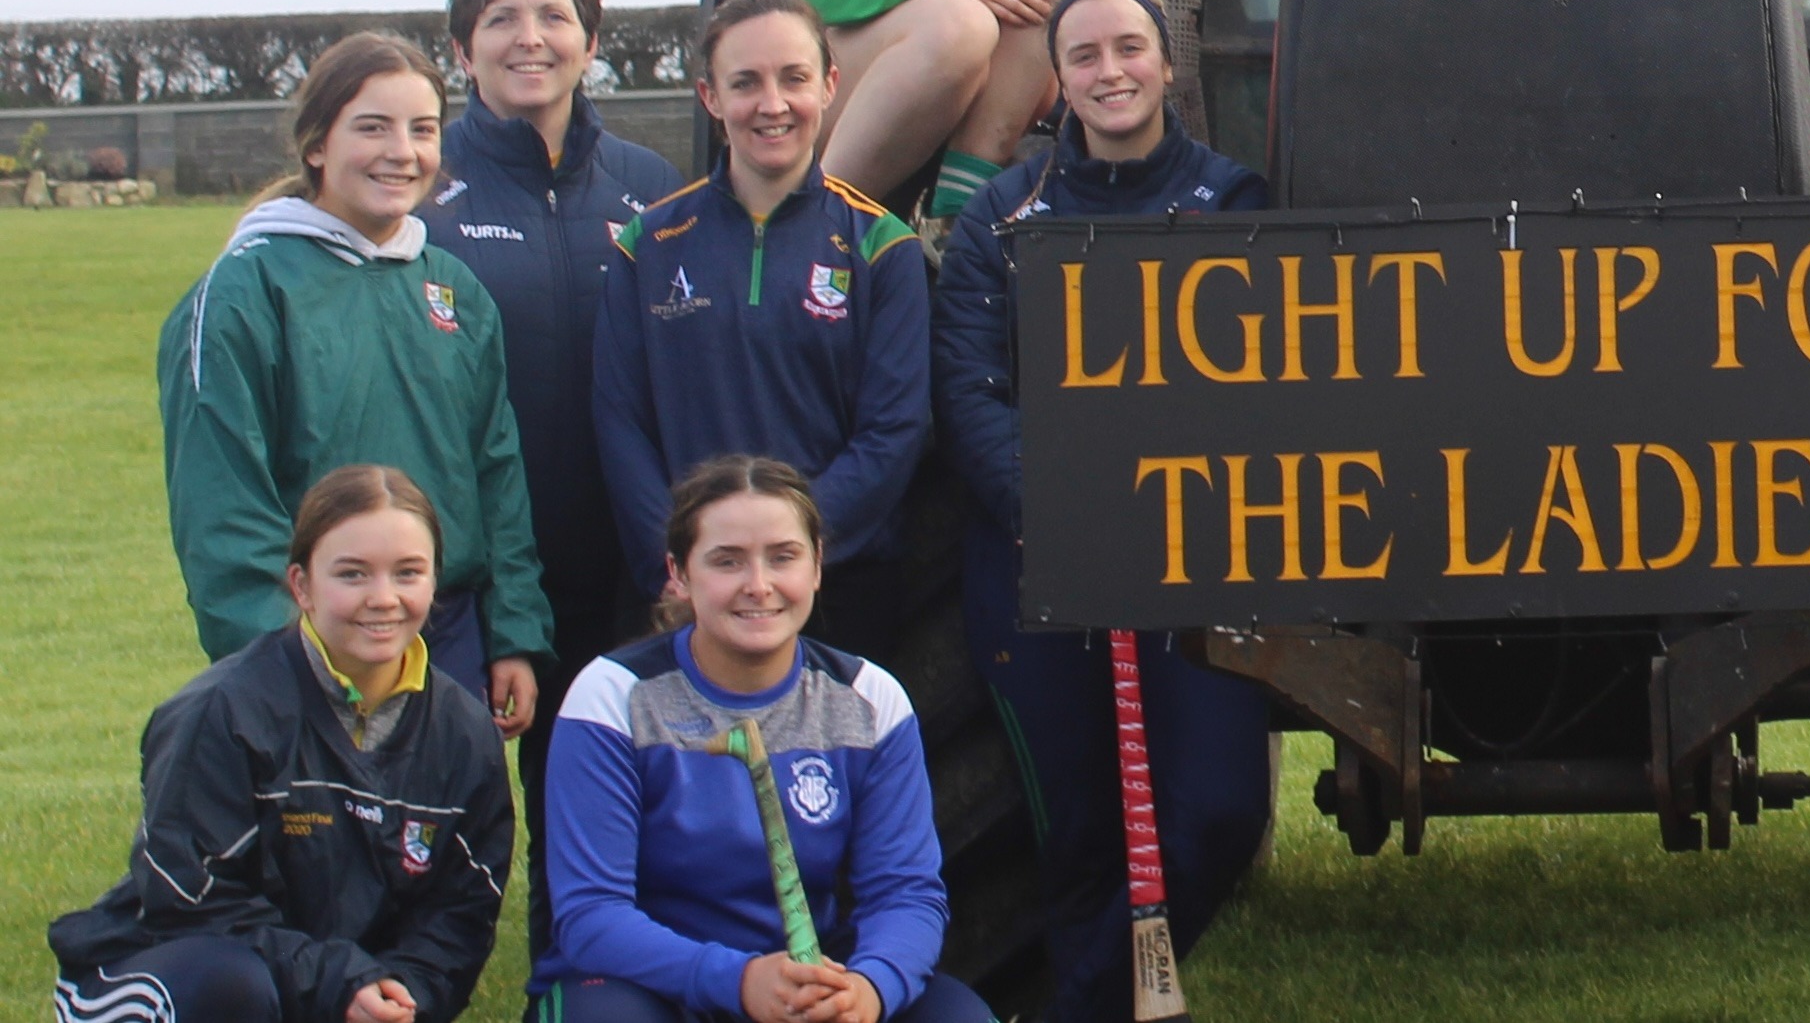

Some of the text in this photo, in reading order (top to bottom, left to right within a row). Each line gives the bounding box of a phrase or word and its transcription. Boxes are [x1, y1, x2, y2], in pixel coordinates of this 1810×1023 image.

[1061, 251, 1446, 389] LIGHT
[1499, 246, 1661, 378] UP
[1134, 450, 1392, 585] THE
